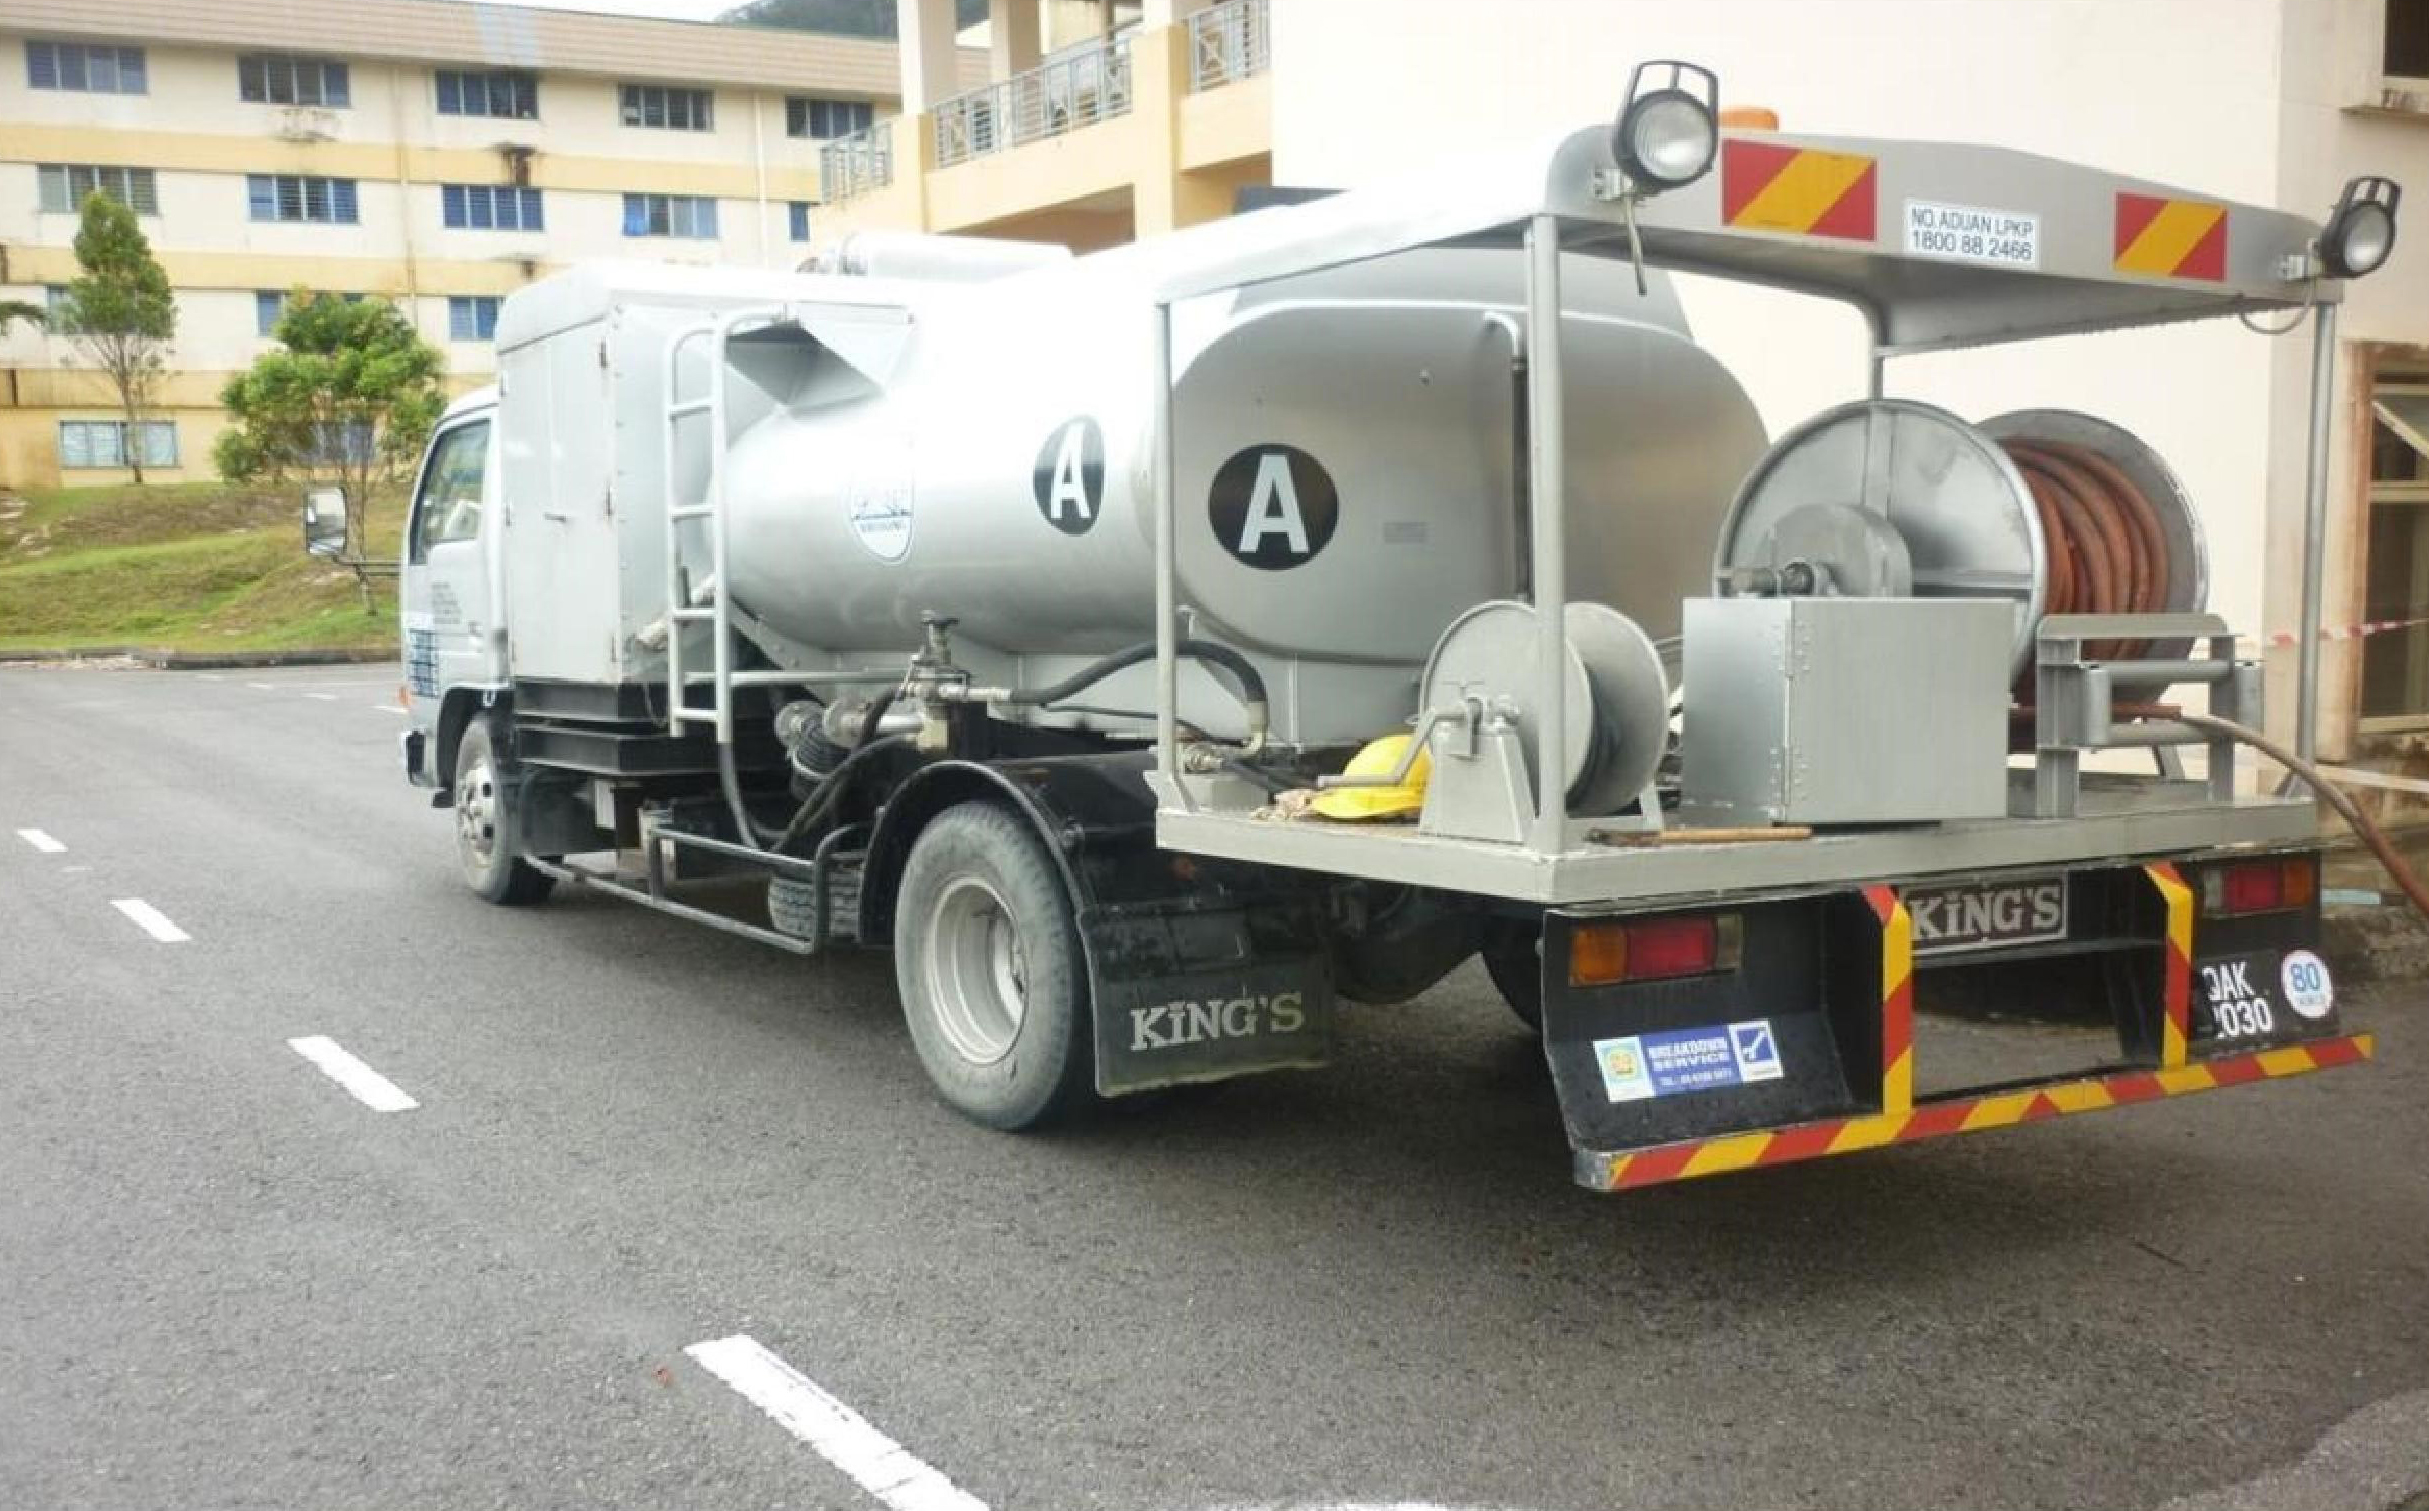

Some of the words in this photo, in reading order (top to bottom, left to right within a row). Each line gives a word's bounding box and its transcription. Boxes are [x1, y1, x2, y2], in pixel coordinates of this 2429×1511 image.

[1995, 219, 2033, 237] LPKP
[1914, 230, 1957, 251] 1800
[1962, 235, 1983, 255] 88
[1989, 237, 2032, 260] 2466
[1050, 421, 1092, 519] A
[1238, 453, 1310, 553] A
[2290, 963, 2321, 991] 80
